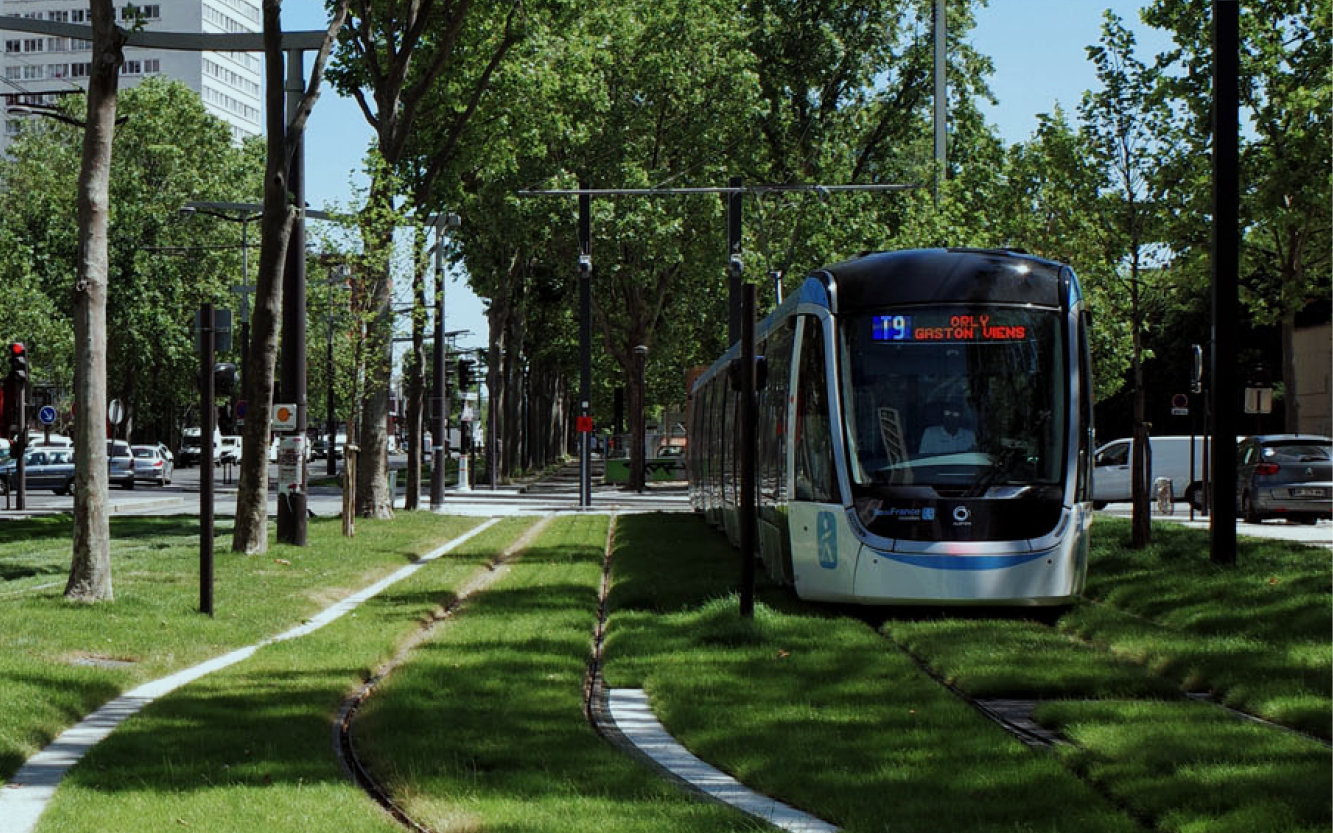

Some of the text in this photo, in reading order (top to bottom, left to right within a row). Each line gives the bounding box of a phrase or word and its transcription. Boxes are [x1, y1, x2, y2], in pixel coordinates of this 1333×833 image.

[950, 315, 990, 327] ORLY
[880, 315, 906, 340] T9
[914, 327, 1025, 339] GASTON VIENS
